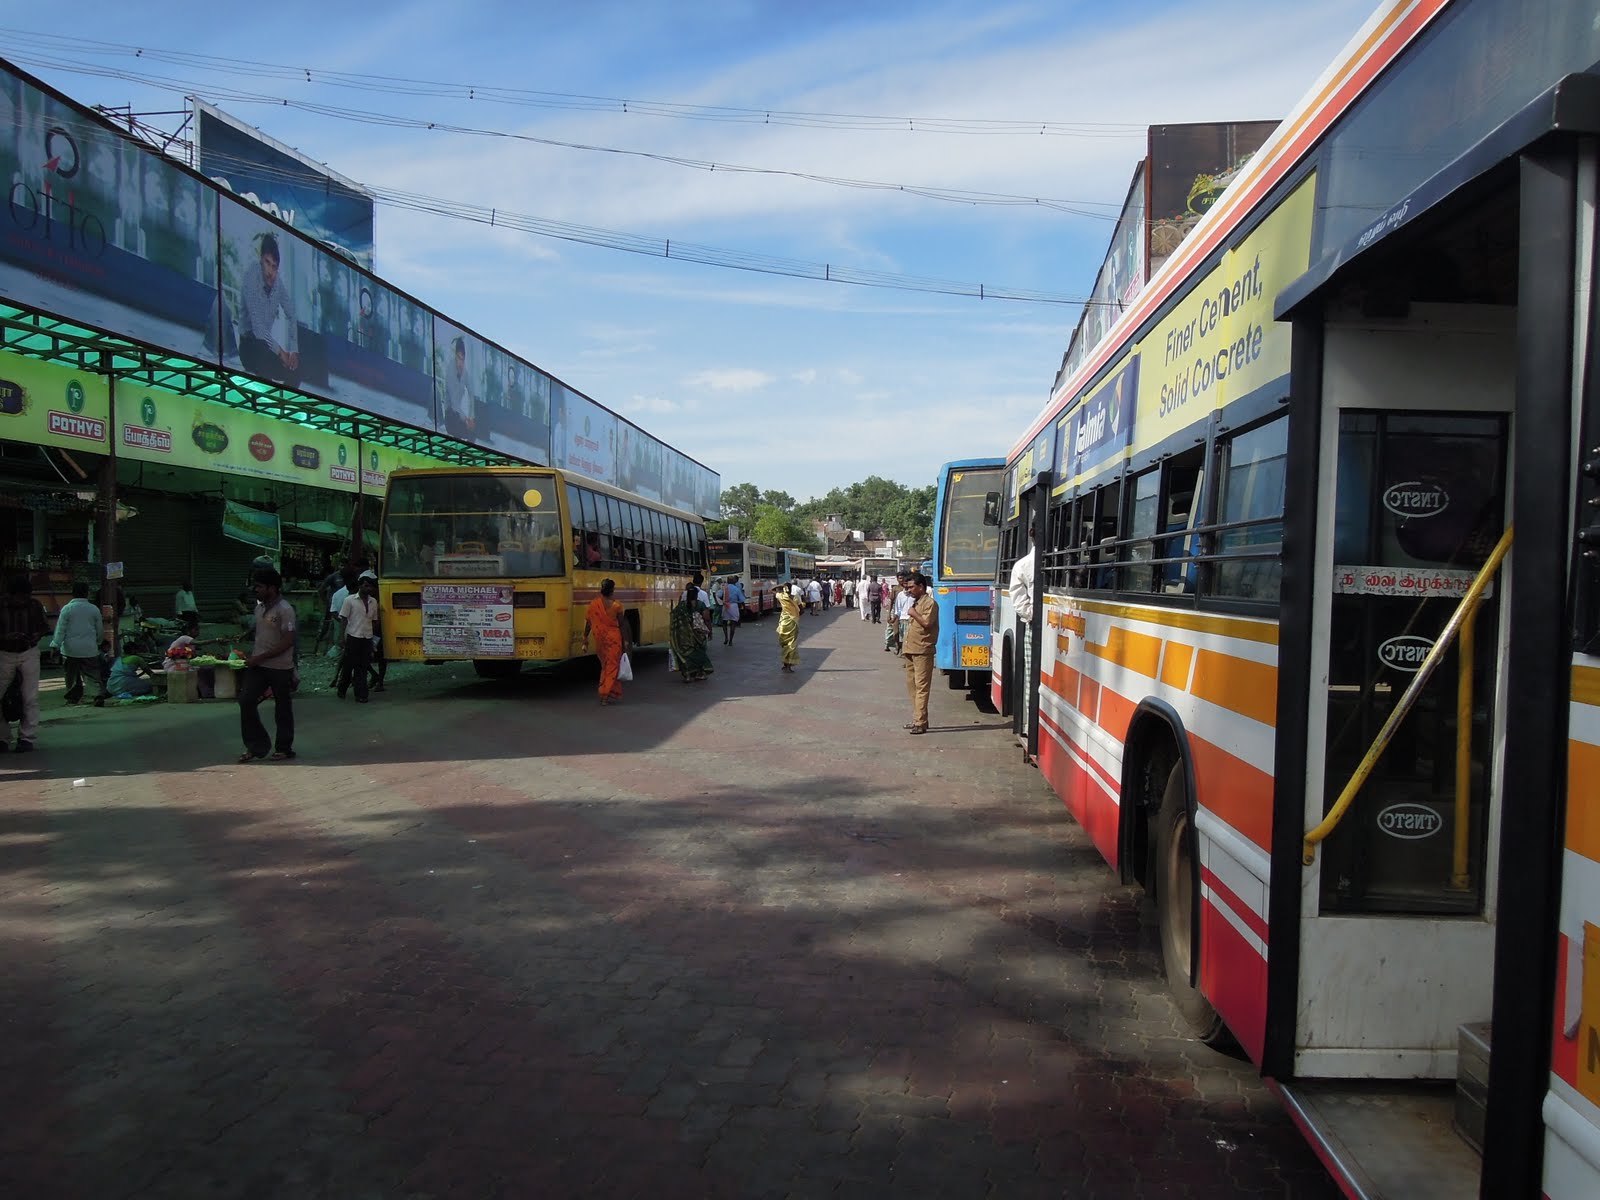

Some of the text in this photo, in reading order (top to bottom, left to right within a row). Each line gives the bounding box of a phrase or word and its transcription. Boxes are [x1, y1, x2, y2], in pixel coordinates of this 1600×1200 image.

[1165, 318, 1197, 367] Finer
[1159, 367, 1190, 418] Solid
[52, 415, 102, 437] POTHYS
[331, 468, 355, 481] POTHYS
[423, 586, 498, 594] FATIMA MICHAEL
[482, 629, 512, 638] MBA
[978, 646, 989, 654] 58
[961, 658, 989, 666] N1364
